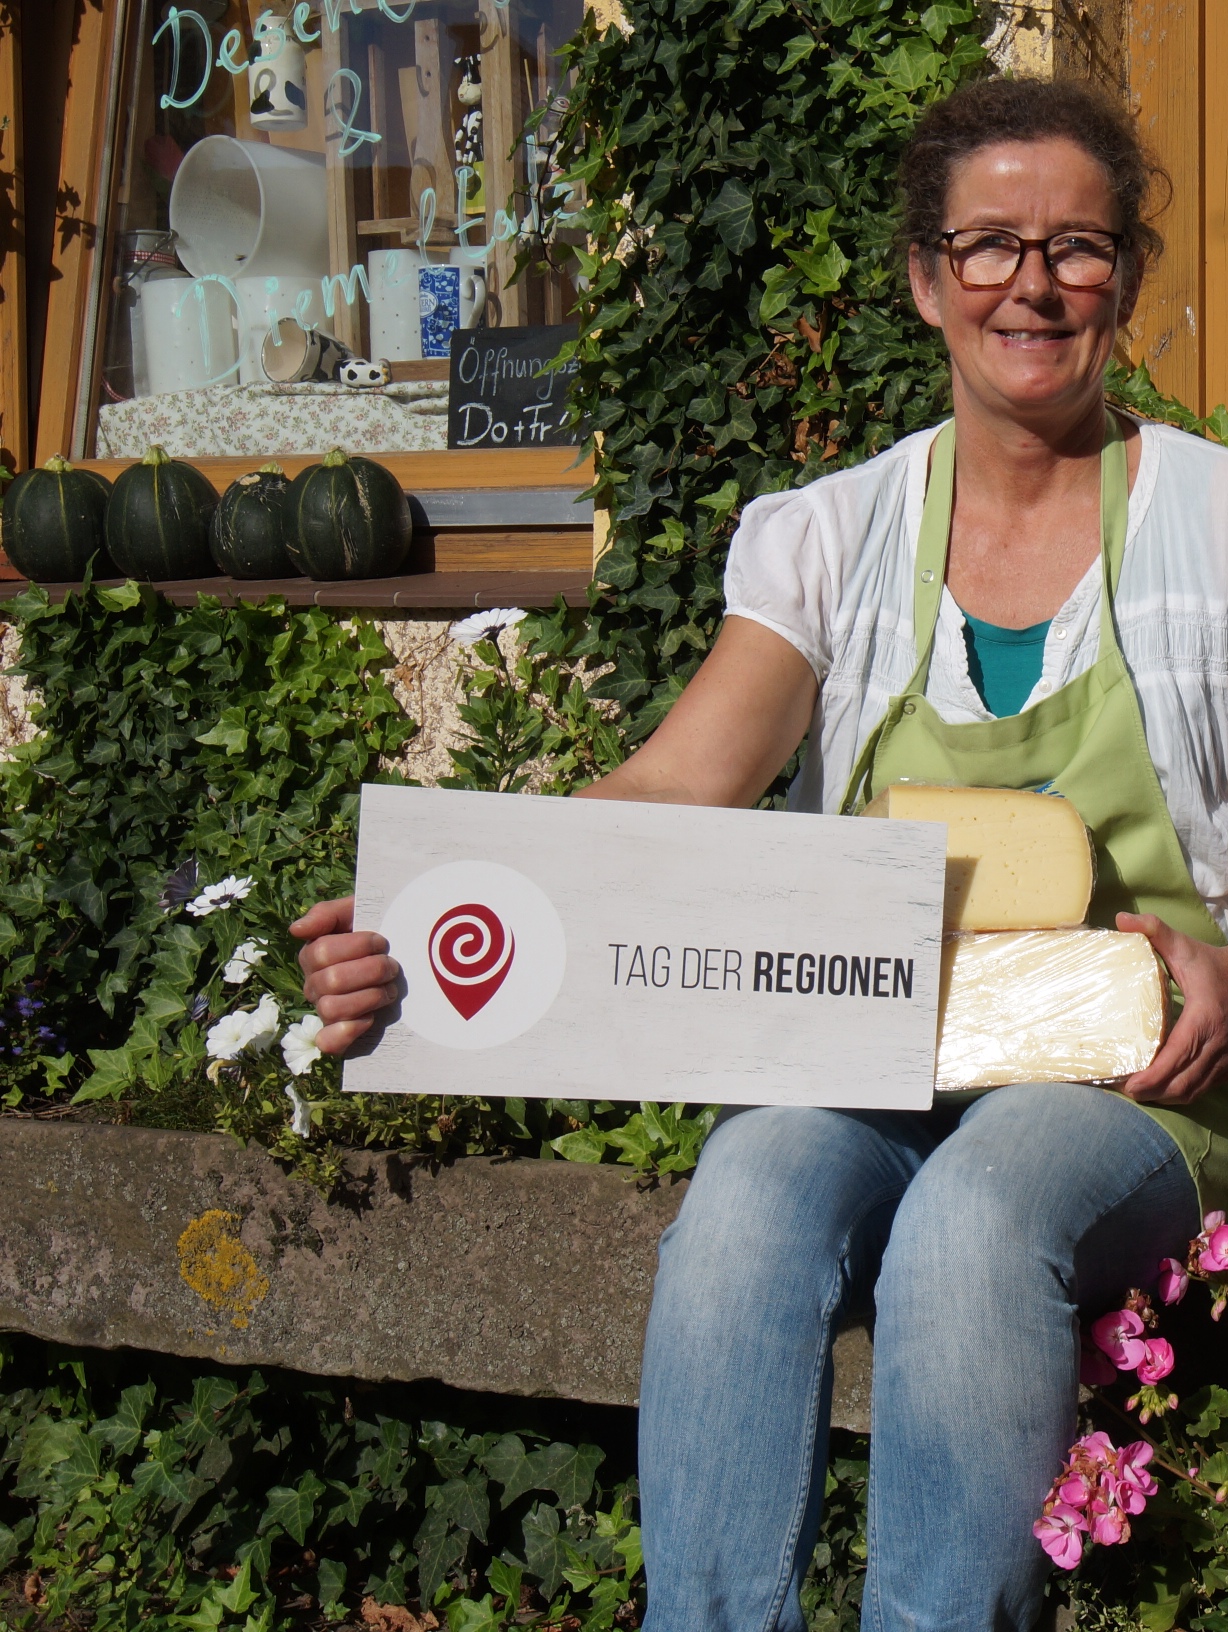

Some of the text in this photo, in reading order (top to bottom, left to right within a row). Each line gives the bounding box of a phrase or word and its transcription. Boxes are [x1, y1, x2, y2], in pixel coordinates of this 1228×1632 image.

[328, 68, 383, 158] &
[607, 942, 915, 999] TAG DER REGIONEN
